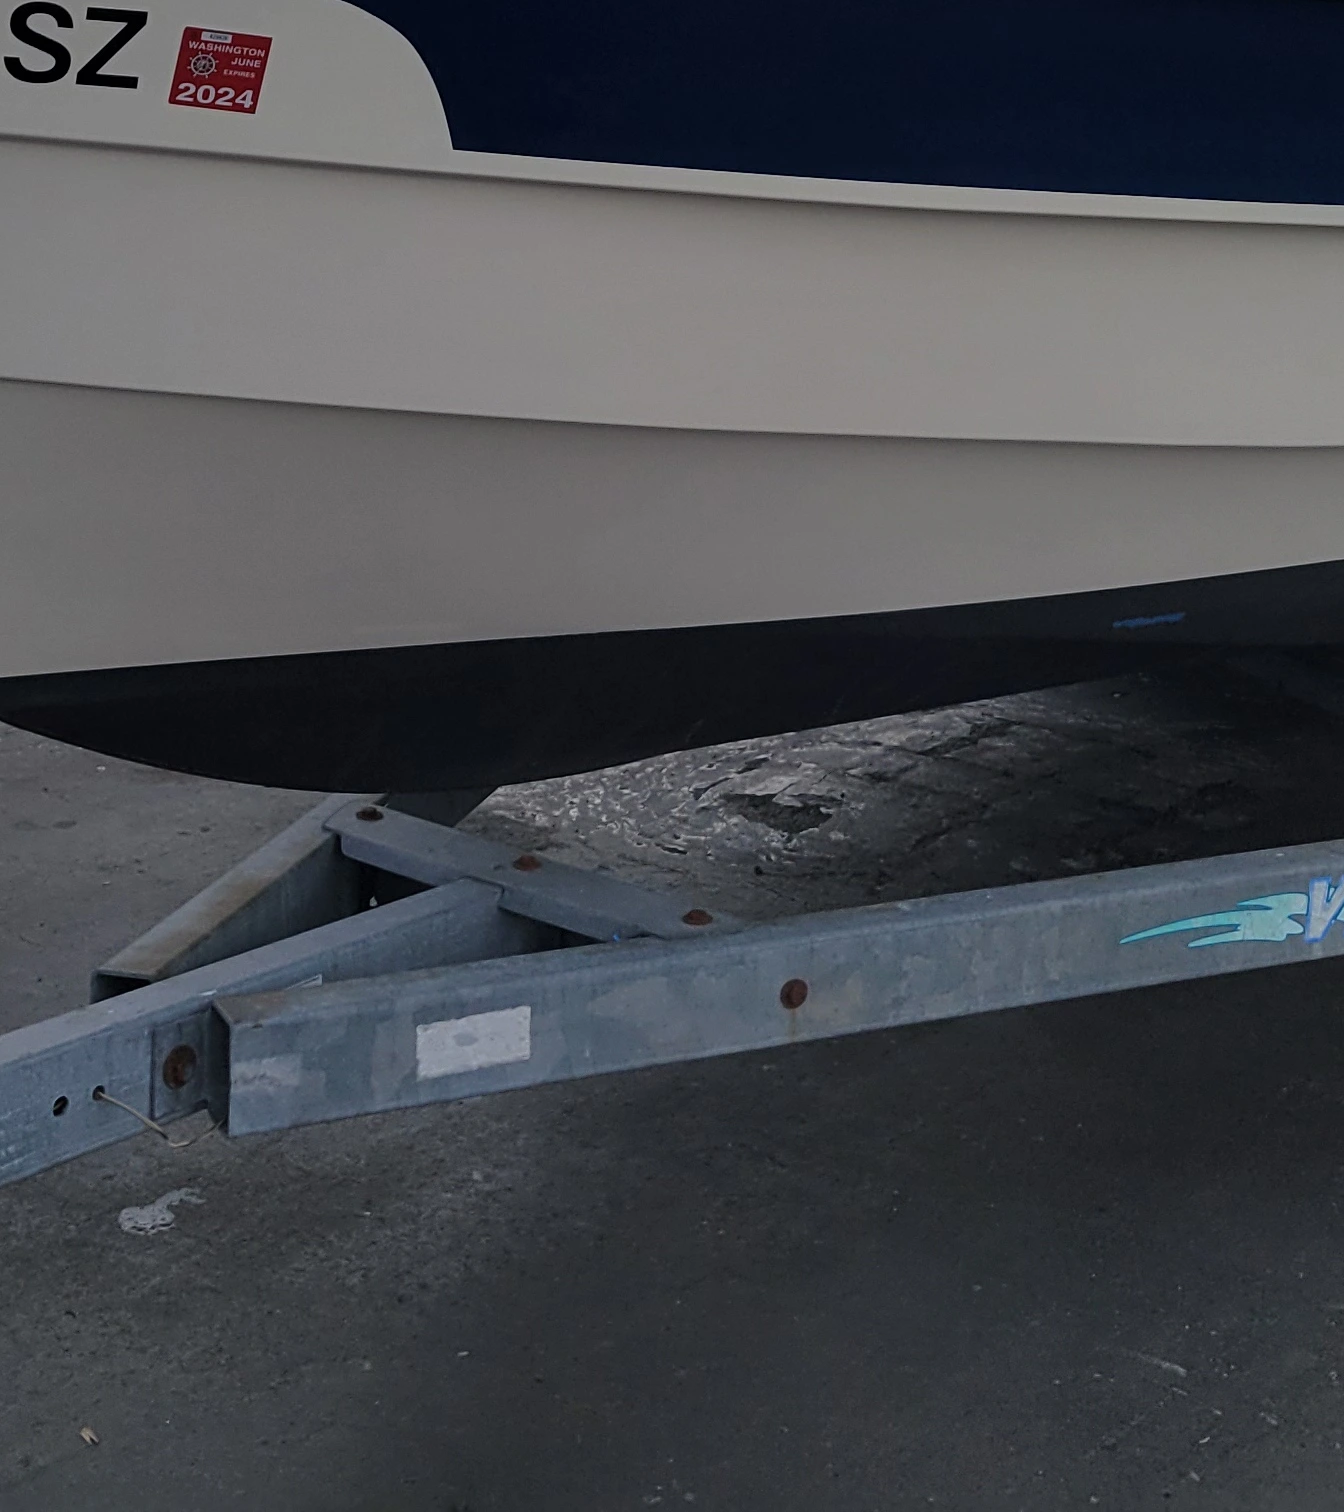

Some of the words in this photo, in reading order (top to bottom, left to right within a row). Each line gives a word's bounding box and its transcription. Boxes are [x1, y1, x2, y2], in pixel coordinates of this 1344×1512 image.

[188, 40, 265, 57] WASHINGTON
[231, 57, 262, 68] JUNE
[223, 69, 255, 78] EXPIRES
[175, 82, 254, 109] 2024
